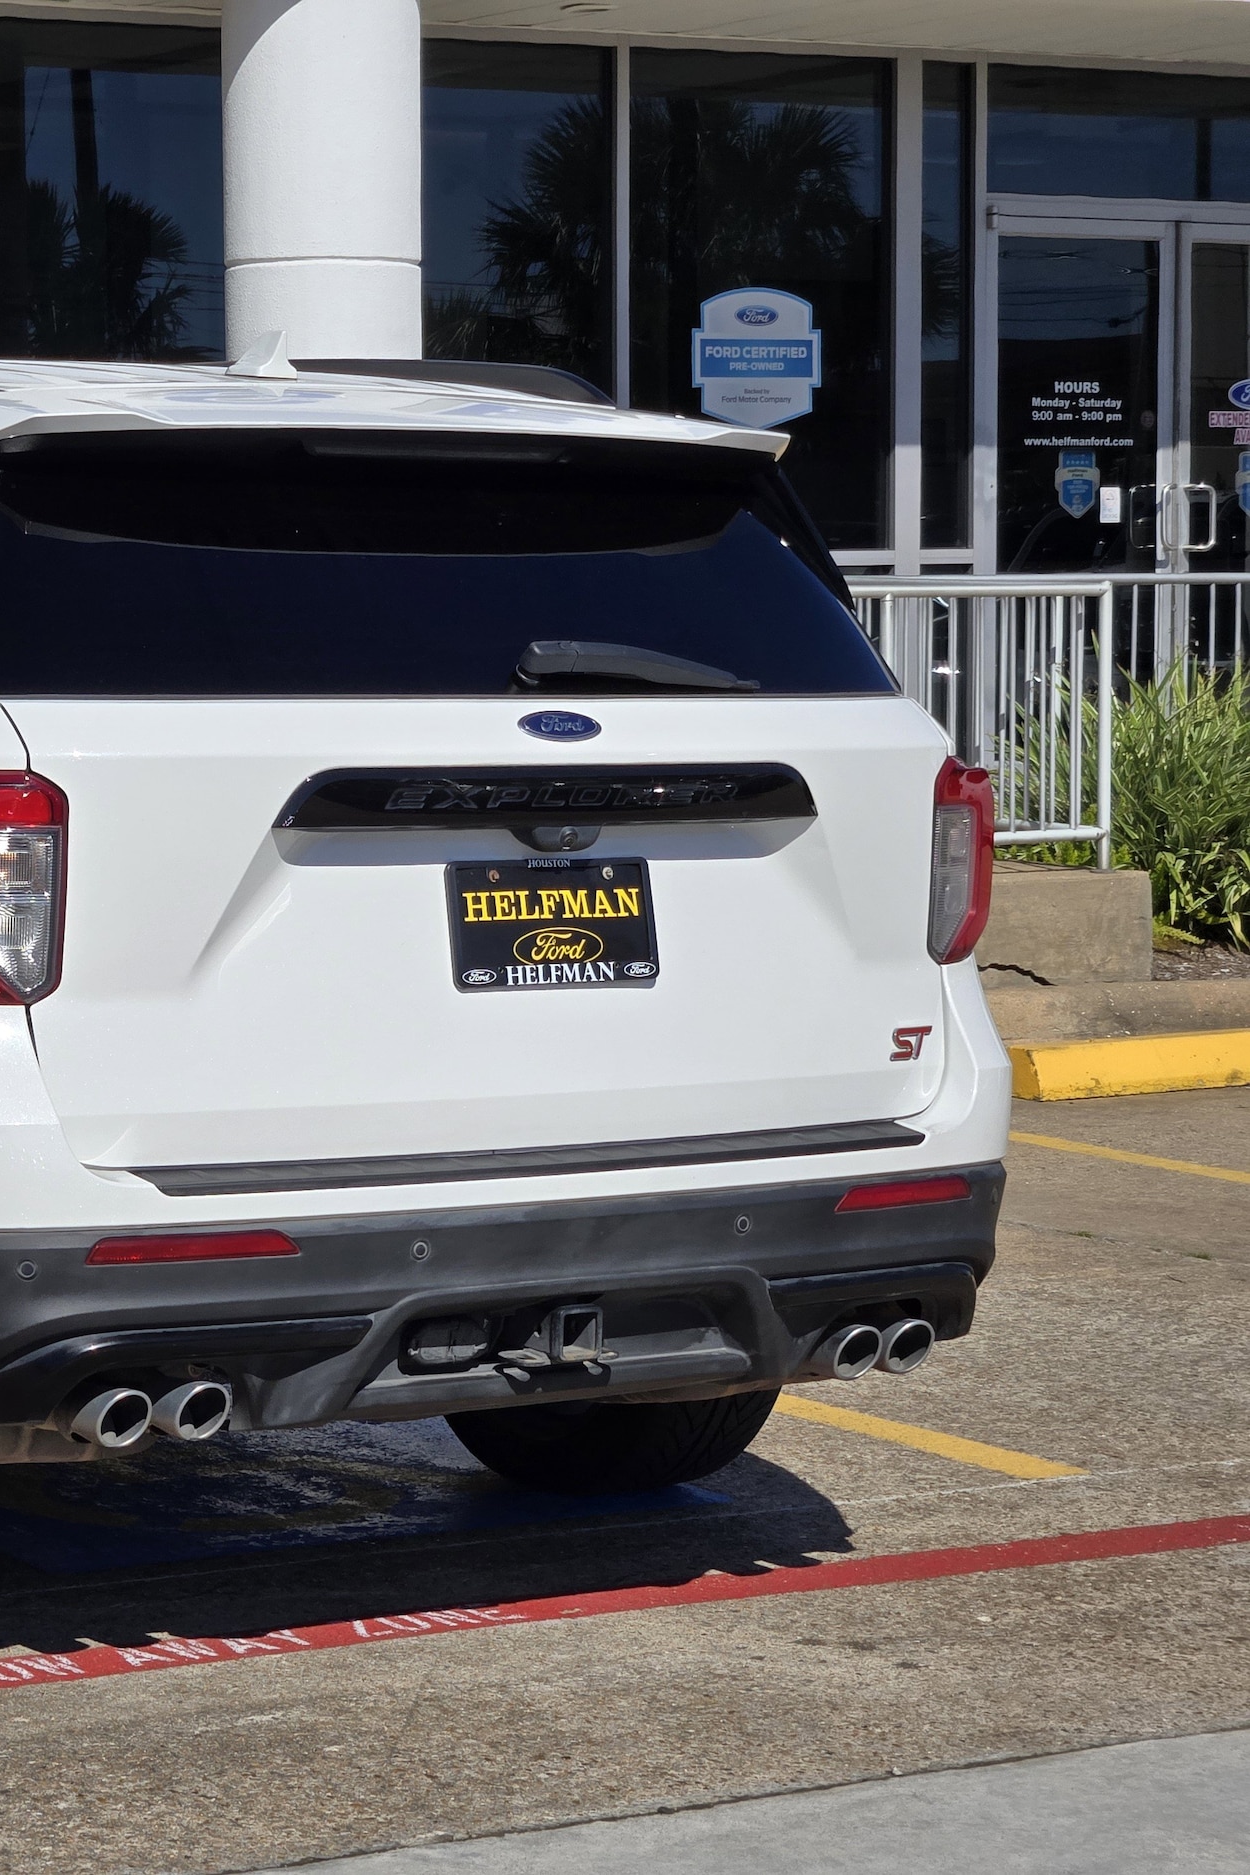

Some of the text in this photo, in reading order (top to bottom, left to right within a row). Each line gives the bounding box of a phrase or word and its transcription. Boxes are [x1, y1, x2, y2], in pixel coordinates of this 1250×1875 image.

[705, 346, 808, 359] FORD CERTIFIED
[729, 362, 785, 371] PRE-OWNED
[1054, 381, 1100, 393] HOURS
[759, 396, 792, 404] Company
[1031, 397, 1070, 409] Monday
[1078, 398, 1122, 410] Saturday
[1031, 410, 1053, 421] 9:00
[1056, 413, 1073, 421] am
[1081, 411, 1104, 421] 9:00
[1106, 413, 1122, 423] pm
[1023, 436, 1134, 447] www.helfmanford.com
[384, 781, 738, 811] EXPLORER
[527, 859, 571, 868] HOUSTON
[462, 888, 640, 922] HELFMAN
[531, 932, 586, 961] Ford
[505, 961, 615, 986] HELFMAN
[889, 1025, 933, 1062] ST
[114, 1629, 311, 1667] AWAY
[351, 1606, 528, 1639] ZONE
